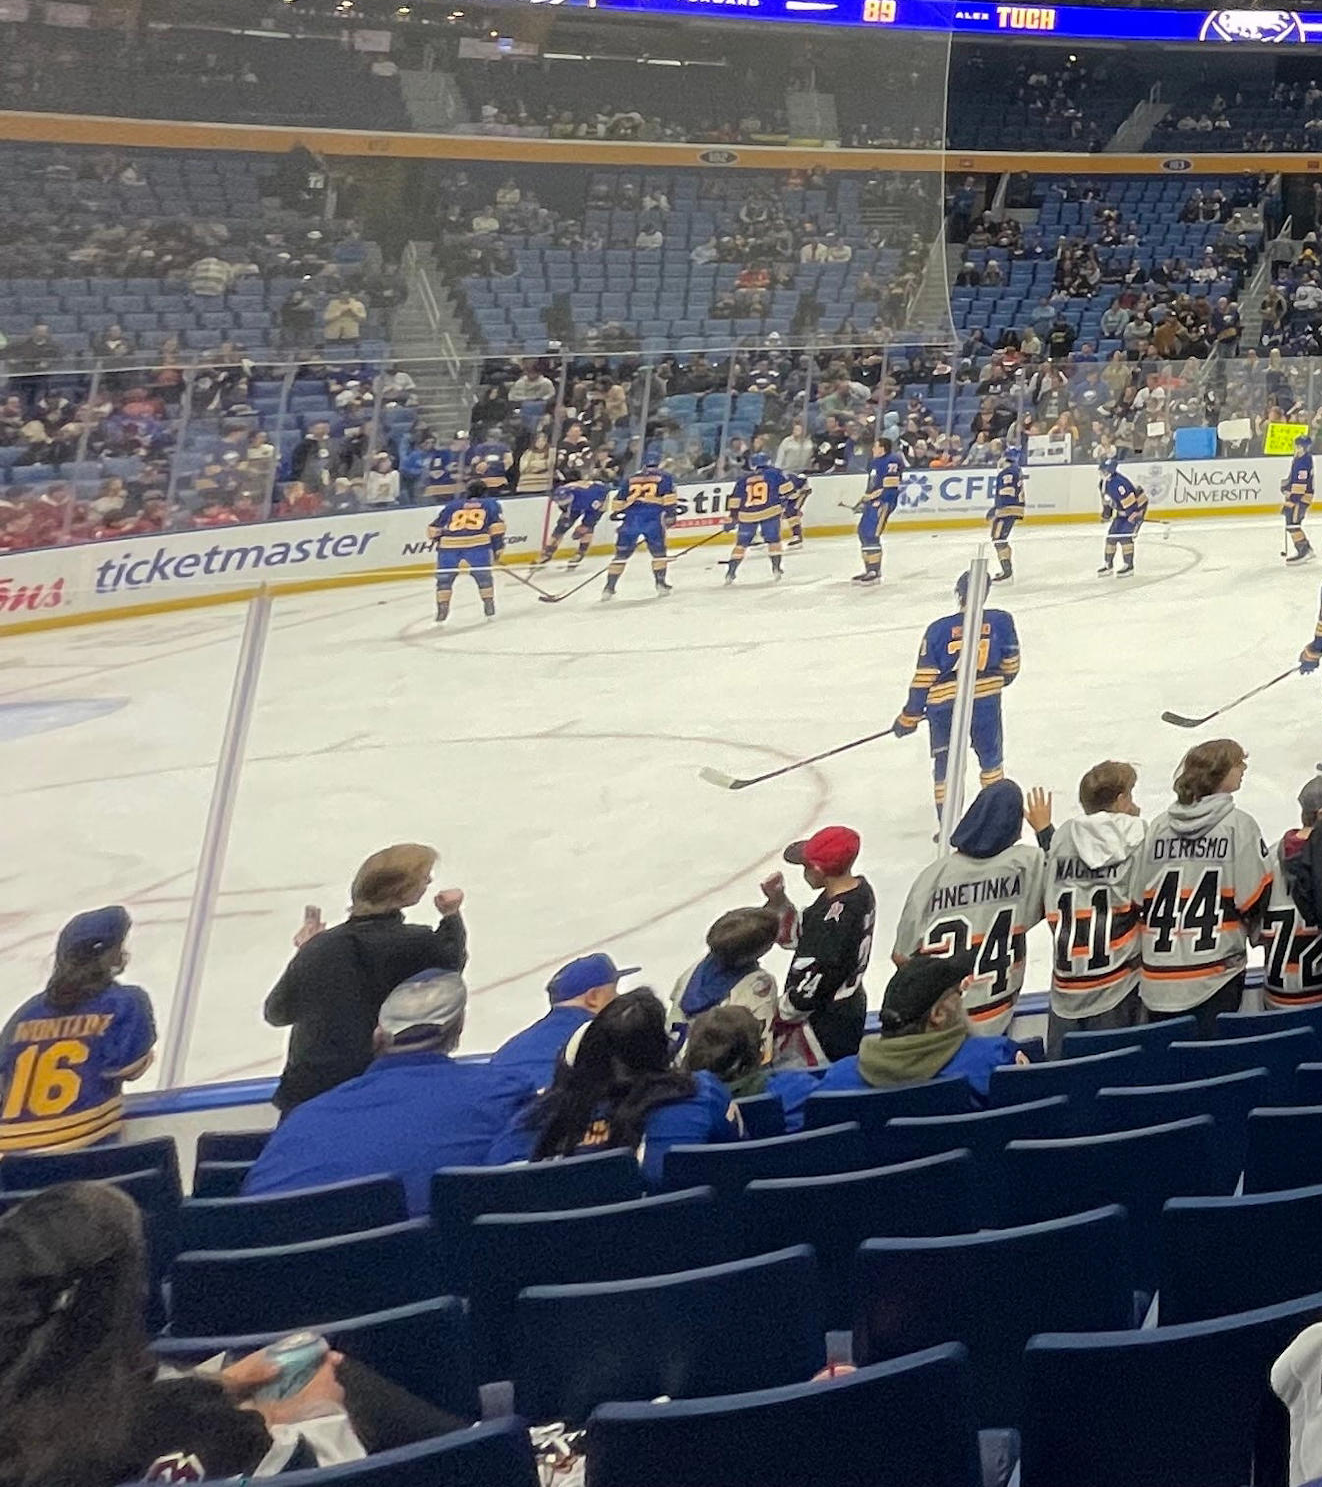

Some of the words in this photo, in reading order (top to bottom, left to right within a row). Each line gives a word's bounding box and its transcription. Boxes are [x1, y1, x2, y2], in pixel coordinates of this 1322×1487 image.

[863, 0, 896, 22] 89
[955, 11, 989, 21] ALEX
[998, 7, 1055, 30] TUCH
[1174, 483, 1263, 503] UNIVERSITY
[1175, 468, 1261, 487] NIAGARA
[96, 531, 380, 593] ticketmaster
[932, 875, 1021, 912] HNETINKA
[1149, 868, 1221, 953] 44
[922, 908, 1015, 995] 24
[1057, 887, 1110, 972] 11
[3, 1040, 89, 1118] 16
